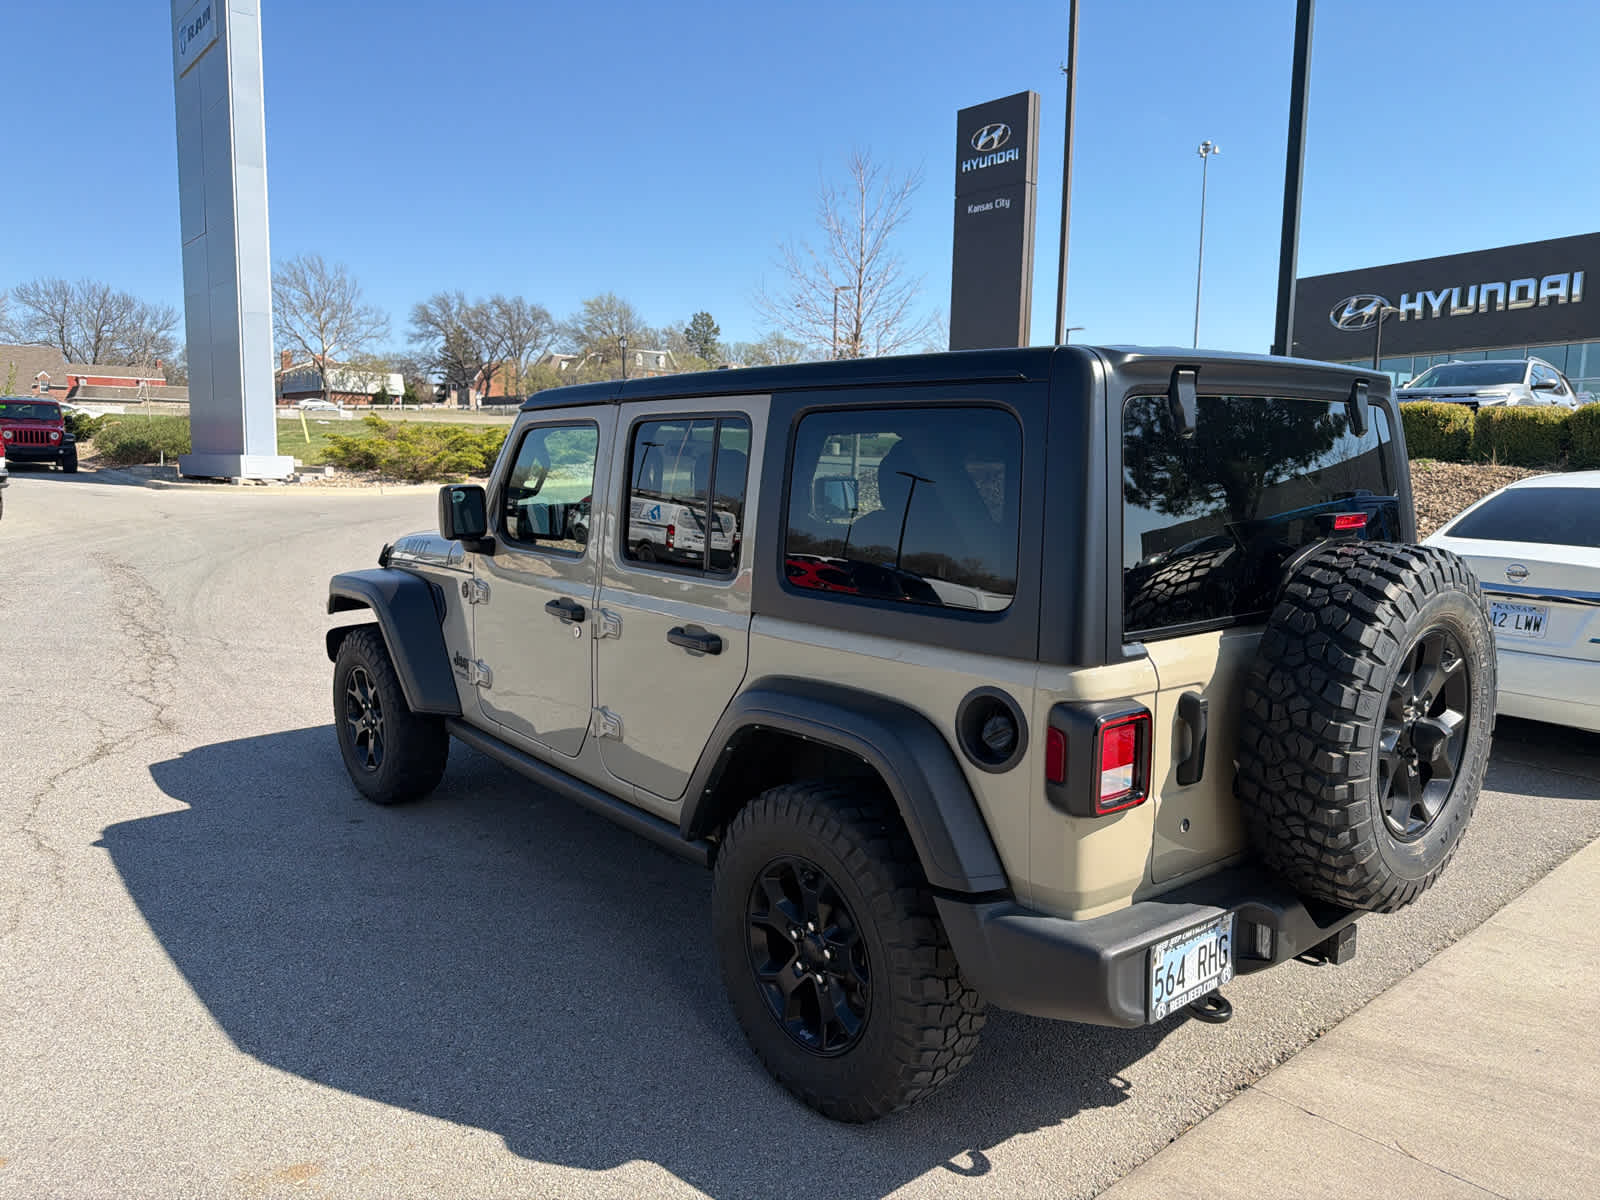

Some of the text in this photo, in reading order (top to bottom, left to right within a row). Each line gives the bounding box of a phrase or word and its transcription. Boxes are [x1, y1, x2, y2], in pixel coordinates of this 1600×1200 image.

[187, 5, 211, 42] RAM
[962, 148, 1019, 173] HYUNDAI
[967, 197, 1011, 214] Kansas City
[1399, 271, 1585, 322] HYUNDAI
[1493, 612, 1542, 632] 12 LWW
[1155, 934, 1228, 1002] 564 RHG
[1169, 977, 1218, 1013] REEDJEEP.COM
